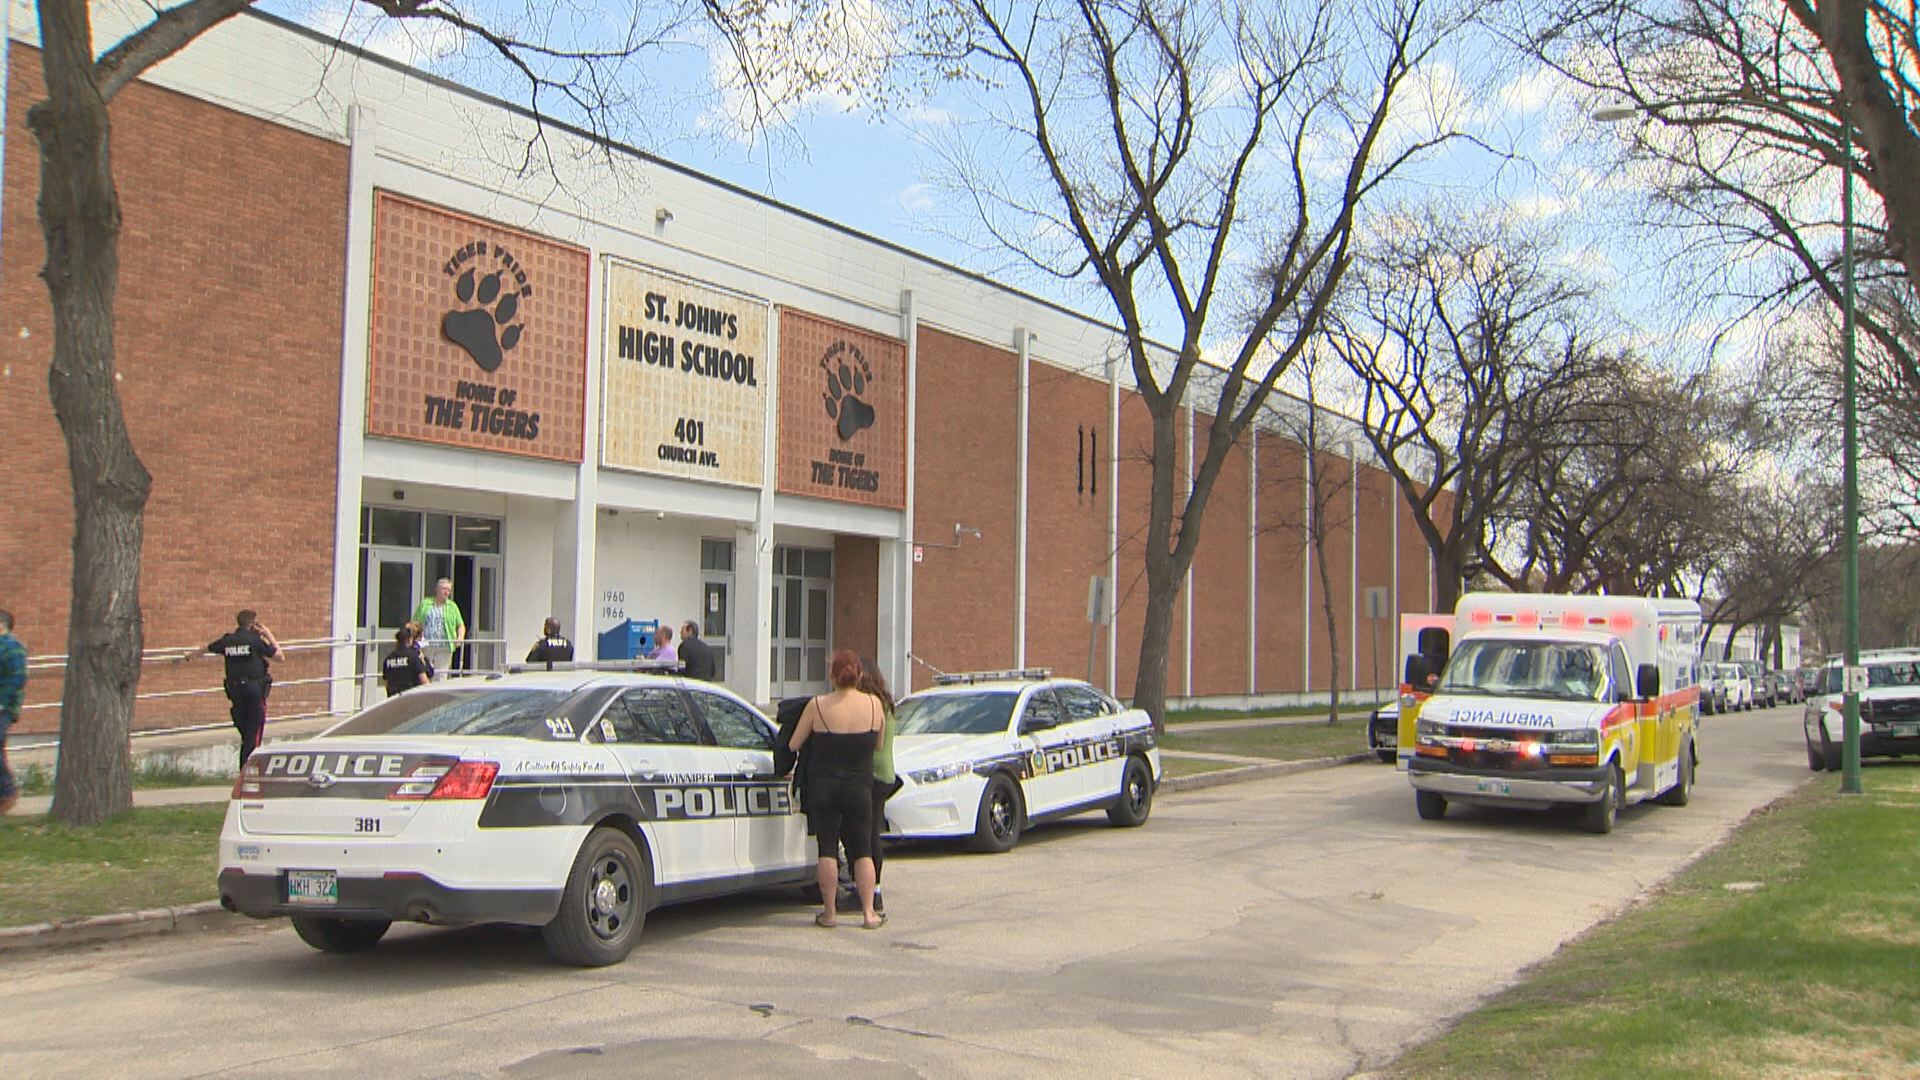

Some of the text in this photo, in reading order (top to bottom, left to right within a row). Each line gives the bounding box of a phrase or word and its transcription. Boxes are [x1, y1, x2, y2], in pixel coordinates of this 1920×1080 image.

[443, 241, 532, 298] TIGER PRIDE
[645, 292, 738, 340] ST. JOHN'S
[618, 325, 757, 387] HIGH SCHOOL
[456, 380, 517, 407] HOME OF
[425, 394, 540, 440] THE TIGERS
[675, 417, 704, 446] 401
[658, 444, 719, 467] CHURCH AVE.
[811, 460, 835, 486] THE
[603, 590, 625, 602] 1960
[602, 607, 624, 619] 1966
[224, 644, 251, 657] POLICE
[264, 754, 404, 777] POLICE
[1046, 740, 1119, 774] POLICE
[653, 783, 792, 819] POLICE
[354, 817, 381, 833] 381
